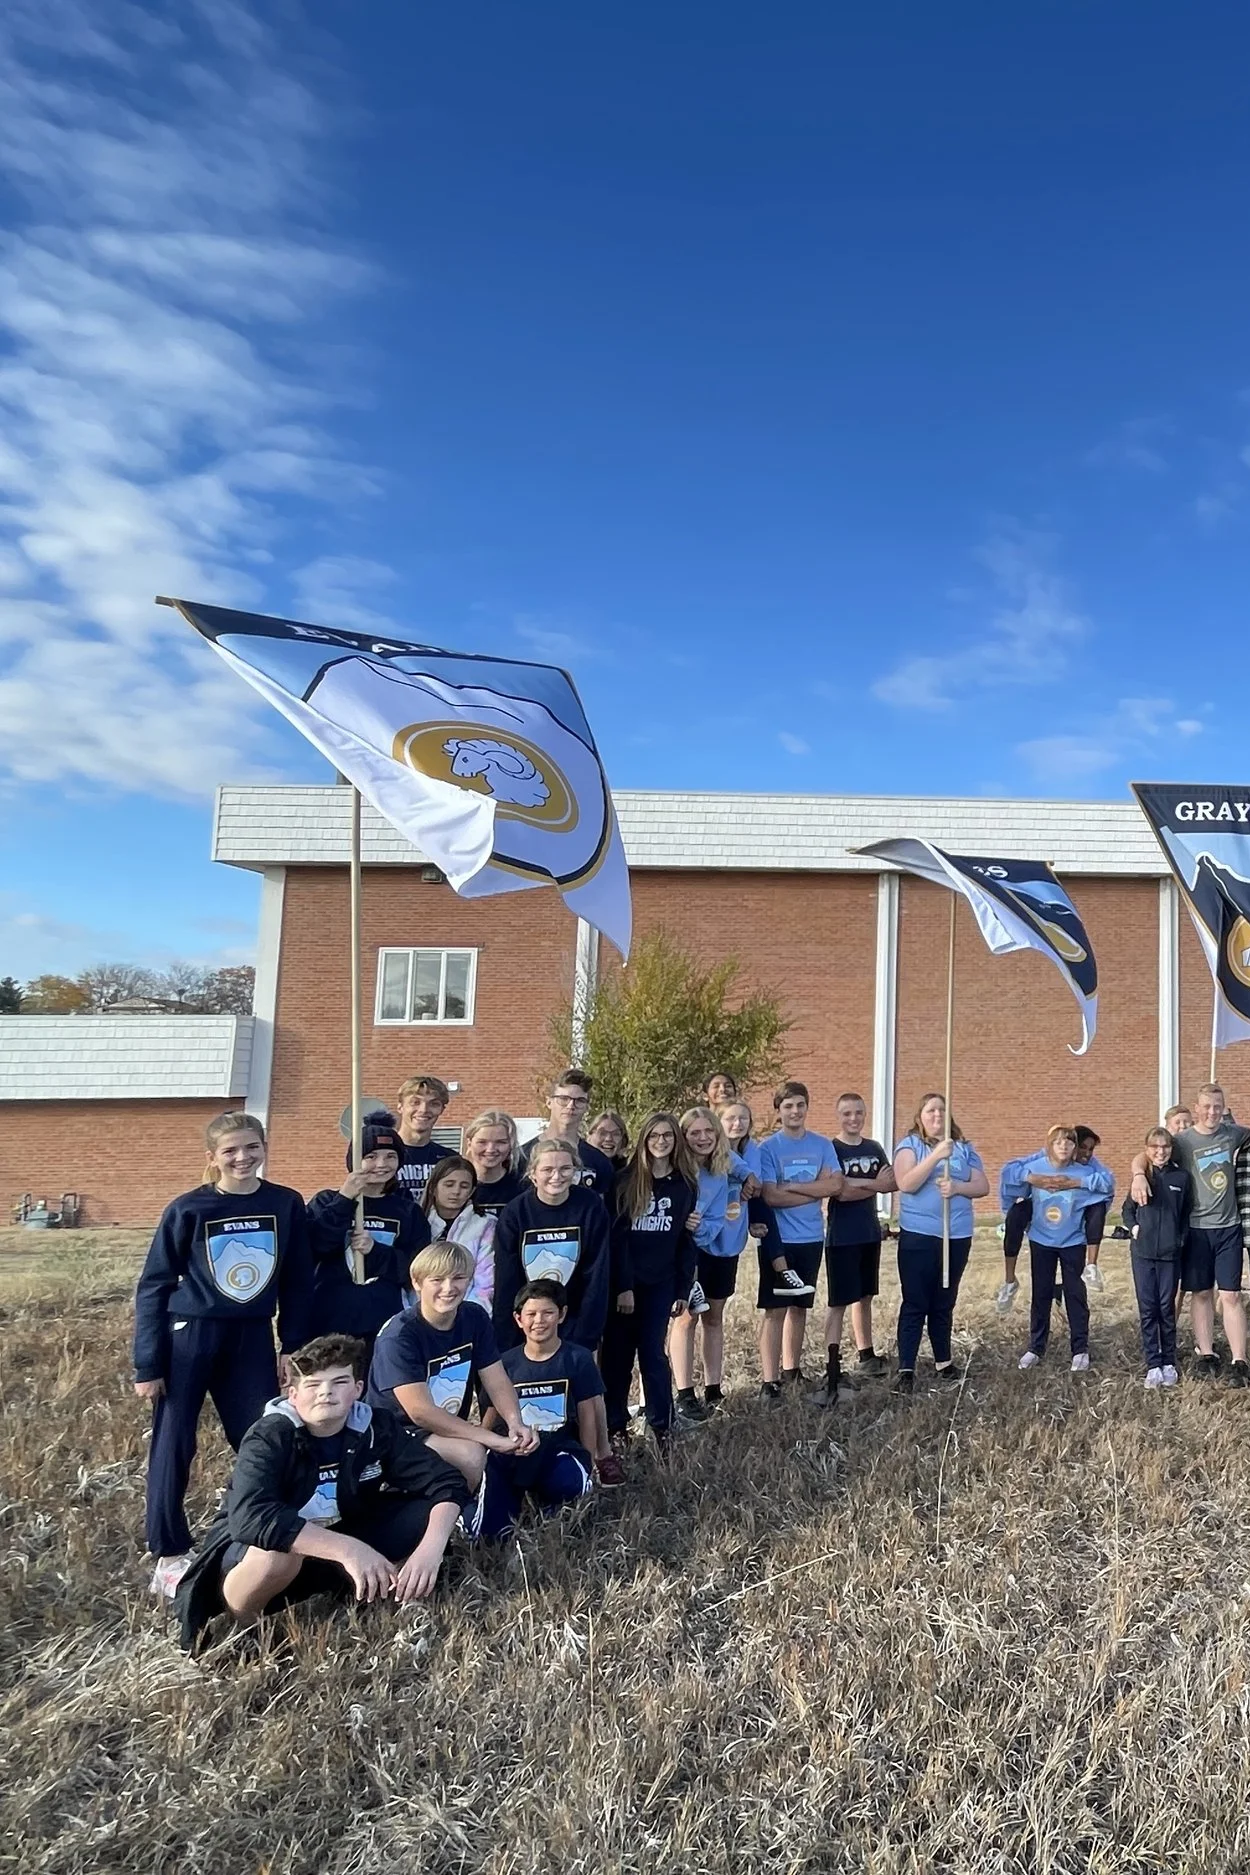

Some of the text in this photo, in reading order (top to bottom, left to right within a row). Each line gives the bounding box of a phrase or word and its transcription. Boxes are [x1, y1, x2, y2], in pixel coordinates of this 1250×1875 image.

[397, 1163, 437, 1181] NIGH
[223, 1221, 260, 1231] EVANS
[537, 1232, 567, 1241] EVANS
[521, 1386, 553, 1396] EVANS
